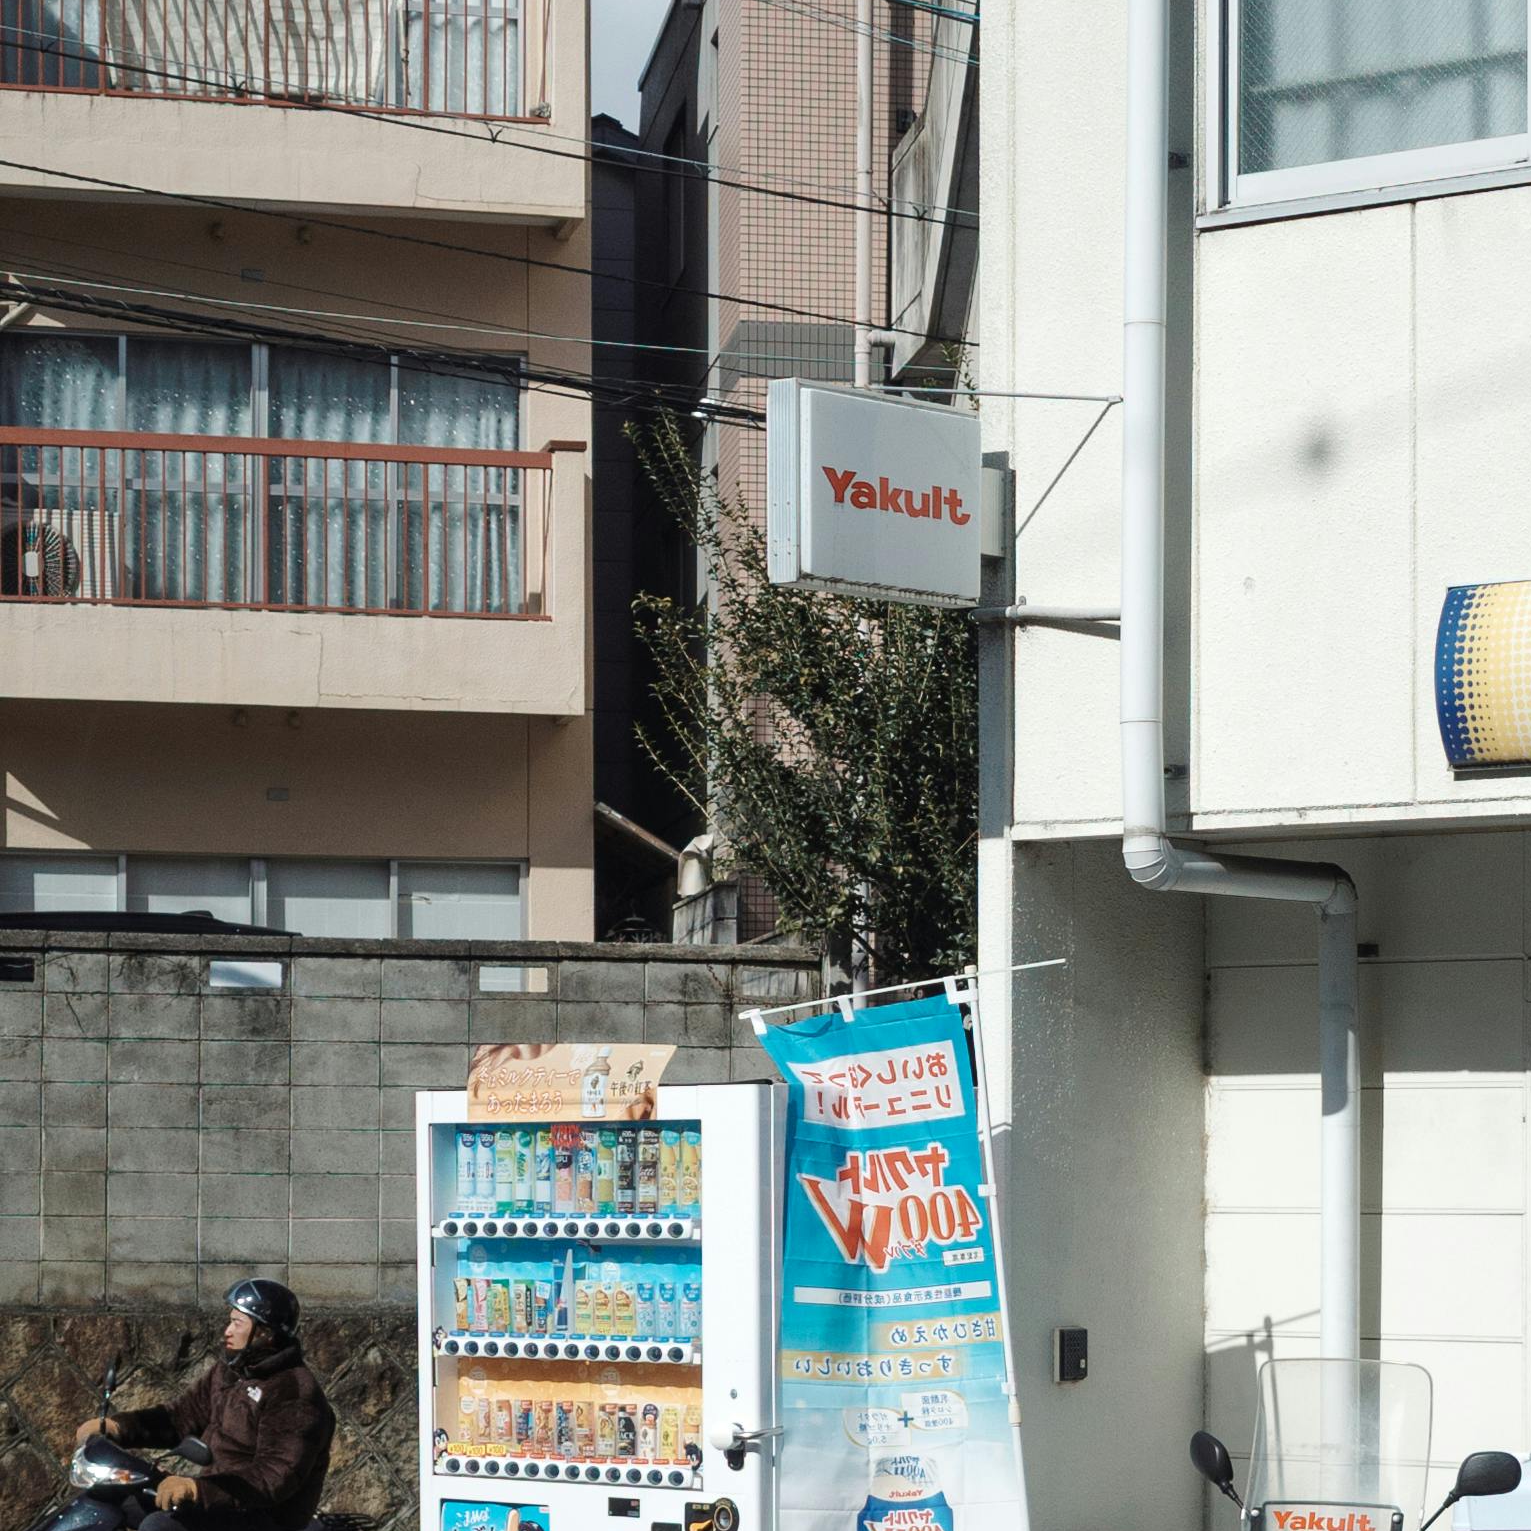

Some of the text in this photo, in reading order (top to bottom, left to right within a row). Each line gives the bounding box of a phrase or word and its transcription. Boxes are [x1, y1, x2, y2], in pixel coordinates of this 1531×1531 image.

[821, 466, 971, 526] Yakult
[488, 1091, 562, 1113] あったまろう
